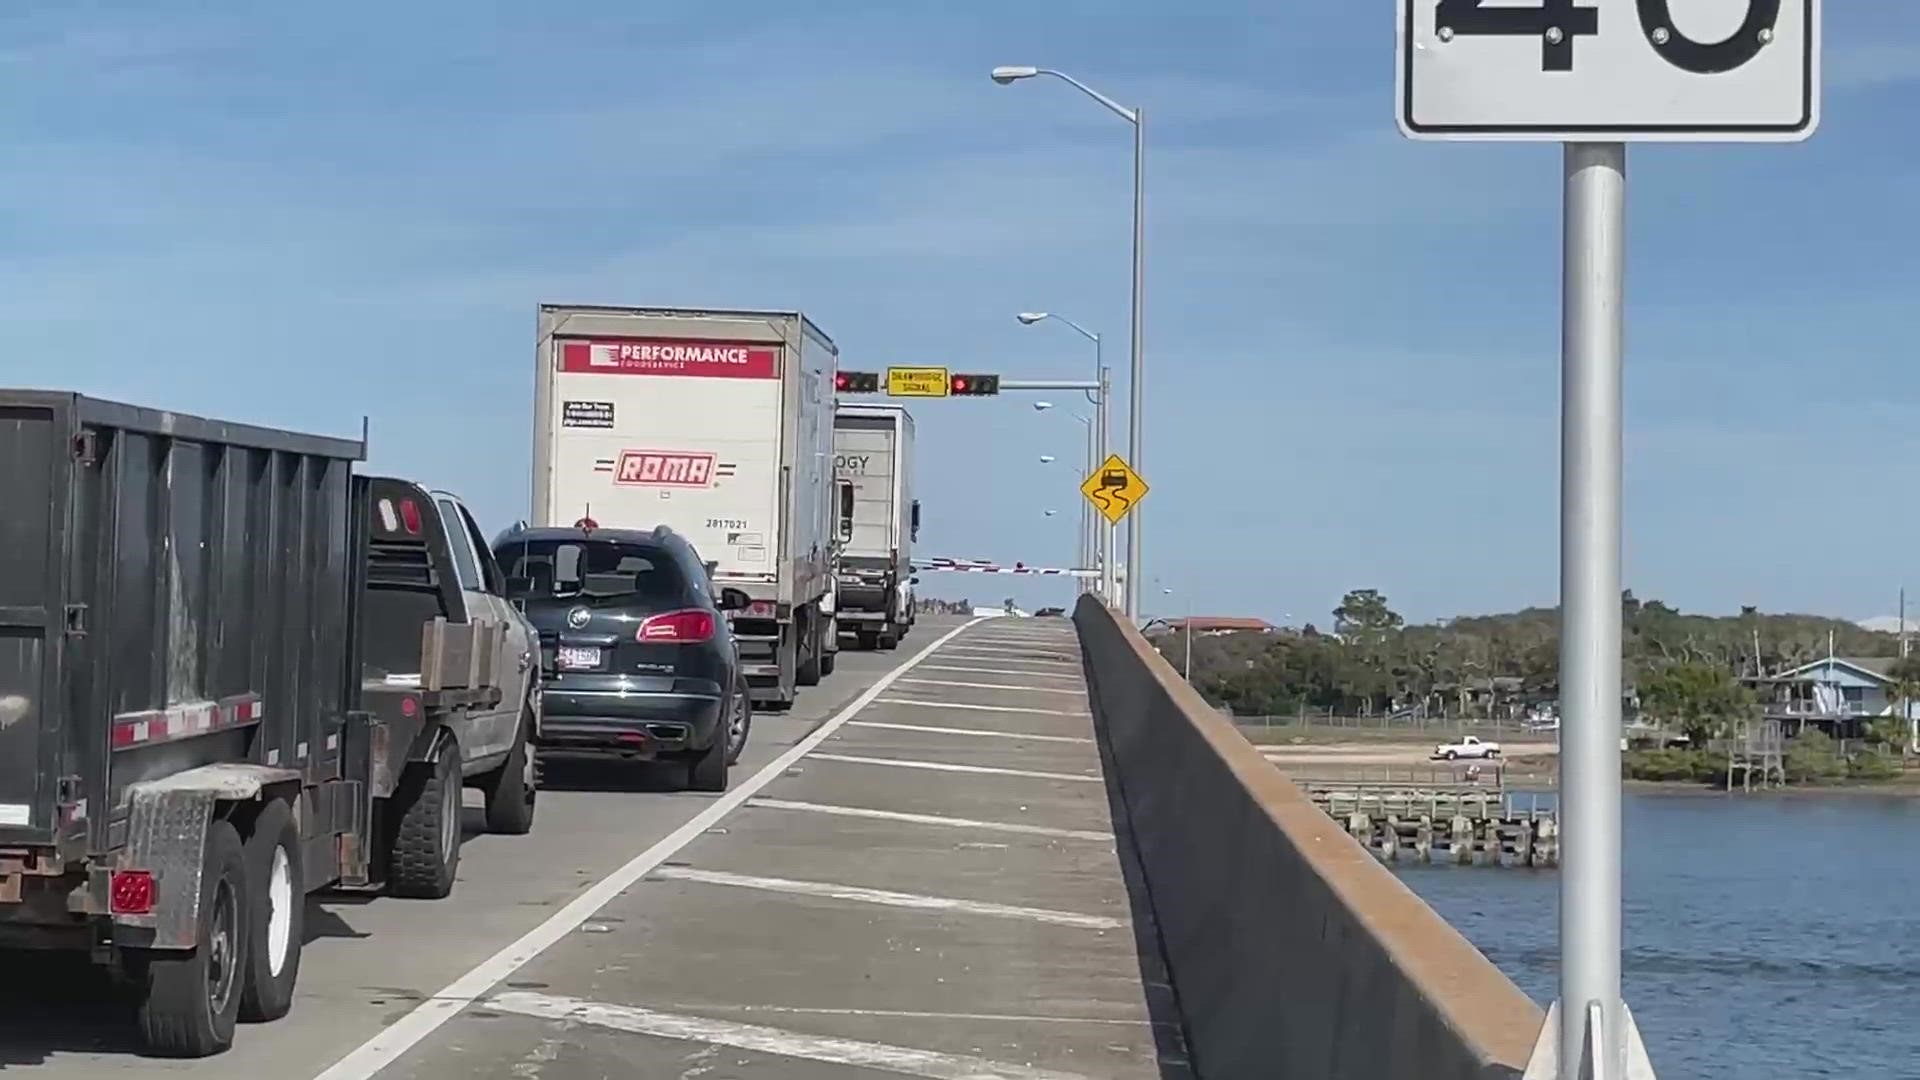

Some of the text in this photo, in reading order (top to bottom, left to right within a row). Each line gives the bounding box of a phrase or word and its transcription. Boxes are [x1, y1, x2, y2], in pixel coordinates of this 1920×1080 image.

[620, 344, 748, 364] PERFORMANCE
[619, 455, 710, 483] ROMA
[705, 519, 748, 529] 2817021
